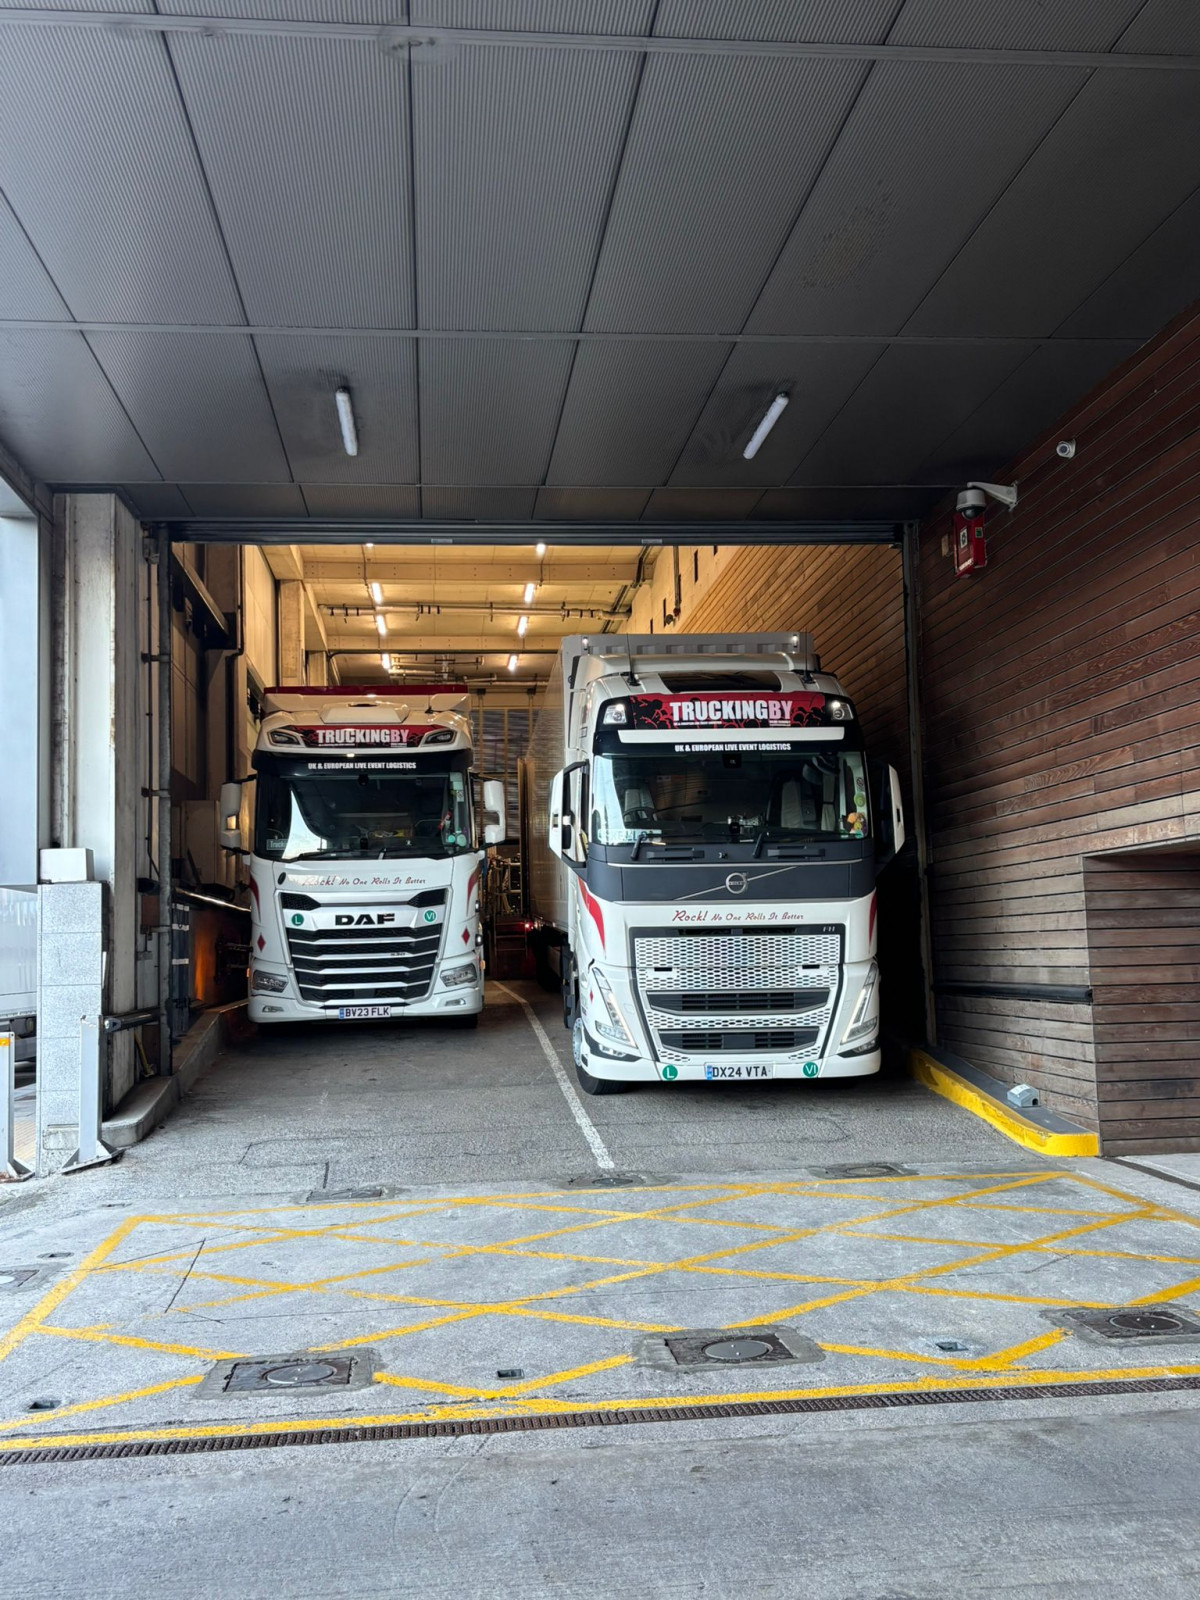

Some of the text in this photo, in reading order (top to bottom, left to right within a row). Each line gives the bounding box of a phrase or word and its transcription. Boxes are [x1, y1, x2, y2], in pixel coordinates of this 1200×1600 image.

[670, 700, 792, 722] TRUCKINGBY
[316, 728, 409, 744] TRUCKINGBY
[675, 744, 684, 752] UK
[685, 744, 691, 752] &
[739, 743, 757, 751] EVENT
[759, 743, 791, 751] LOGISTICS
[324, 762, 354, 770] EUROPEAN
[371, 877, 391, 885] Rolls
[392, 877, 402, 885] It
[405, 876, 426, 884] Better
[294, 916, 301, 924] L
[335, 913, 395, 926] DAF
[426, 912, 435, 920] VI
[672, 910, 708, 922] Rock!
[726, 913, 741, 921] One
[745, 912, 766, 921] Rolls
[768, 912, 778, 920] It
[781, 912, 804, 920] Better
[345, 1006, 390, 1017] BV23 FLK
[666, 1066, 675, 1079] L
[712, 1065, 768, 1078] DX24 VTA
[806, 1065, 817, 1074] VI
